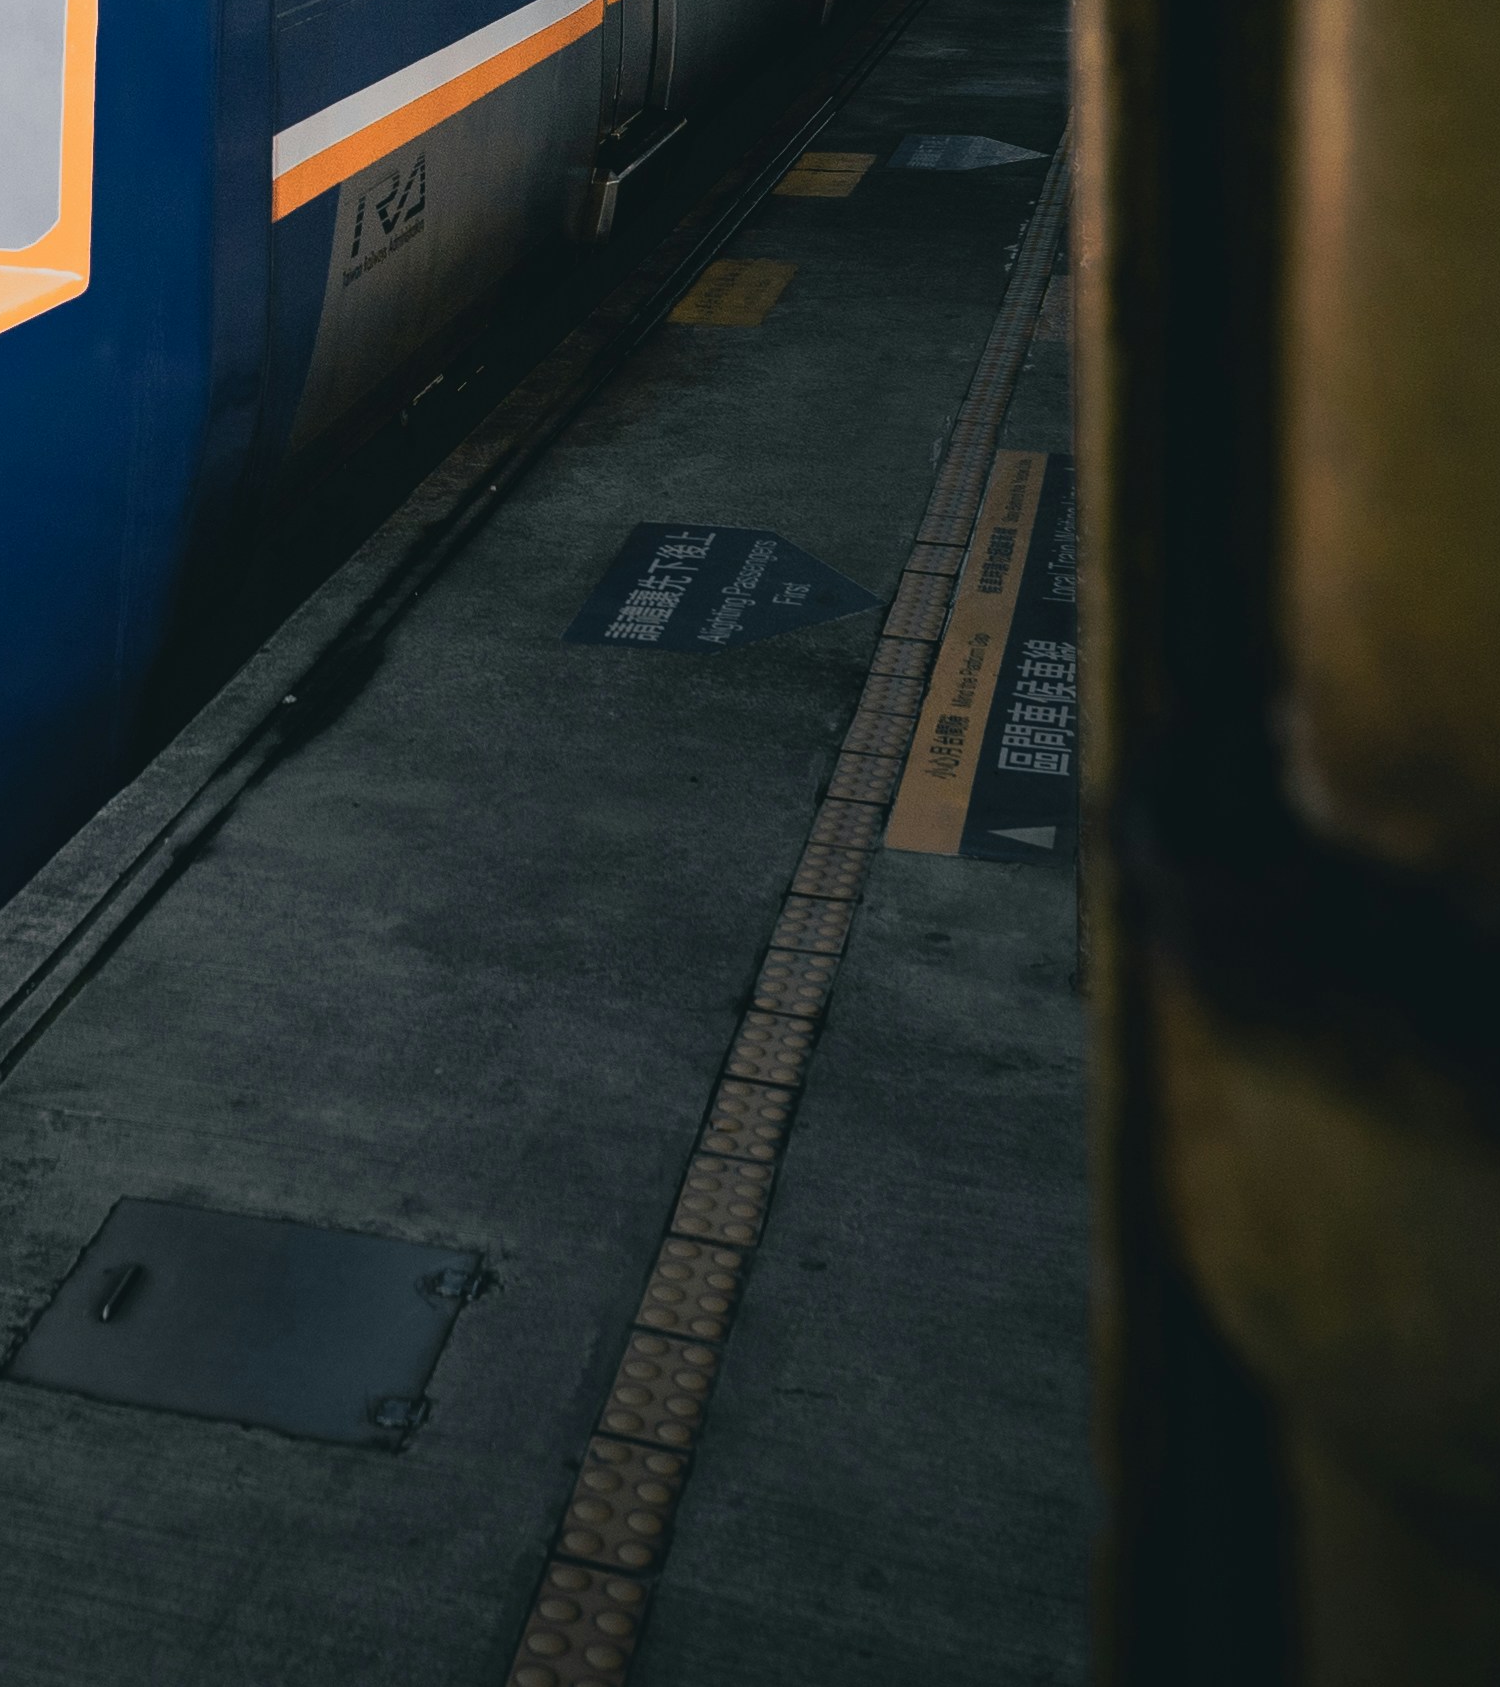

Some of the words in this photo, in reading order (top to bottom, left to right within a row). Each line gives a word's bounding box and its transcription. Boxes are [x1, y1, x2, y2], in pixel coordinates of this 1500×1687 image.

[604, 531, 716, 642] 請禮讓先下後上
[721, 539, 778, 597] Passengers
[772, 582, 811, 606] First
[1042, 571, 1076, 603] Local
[697, 597, 756, 645] Alighting
[998, 639, 1077, 776] 區間車候車線
